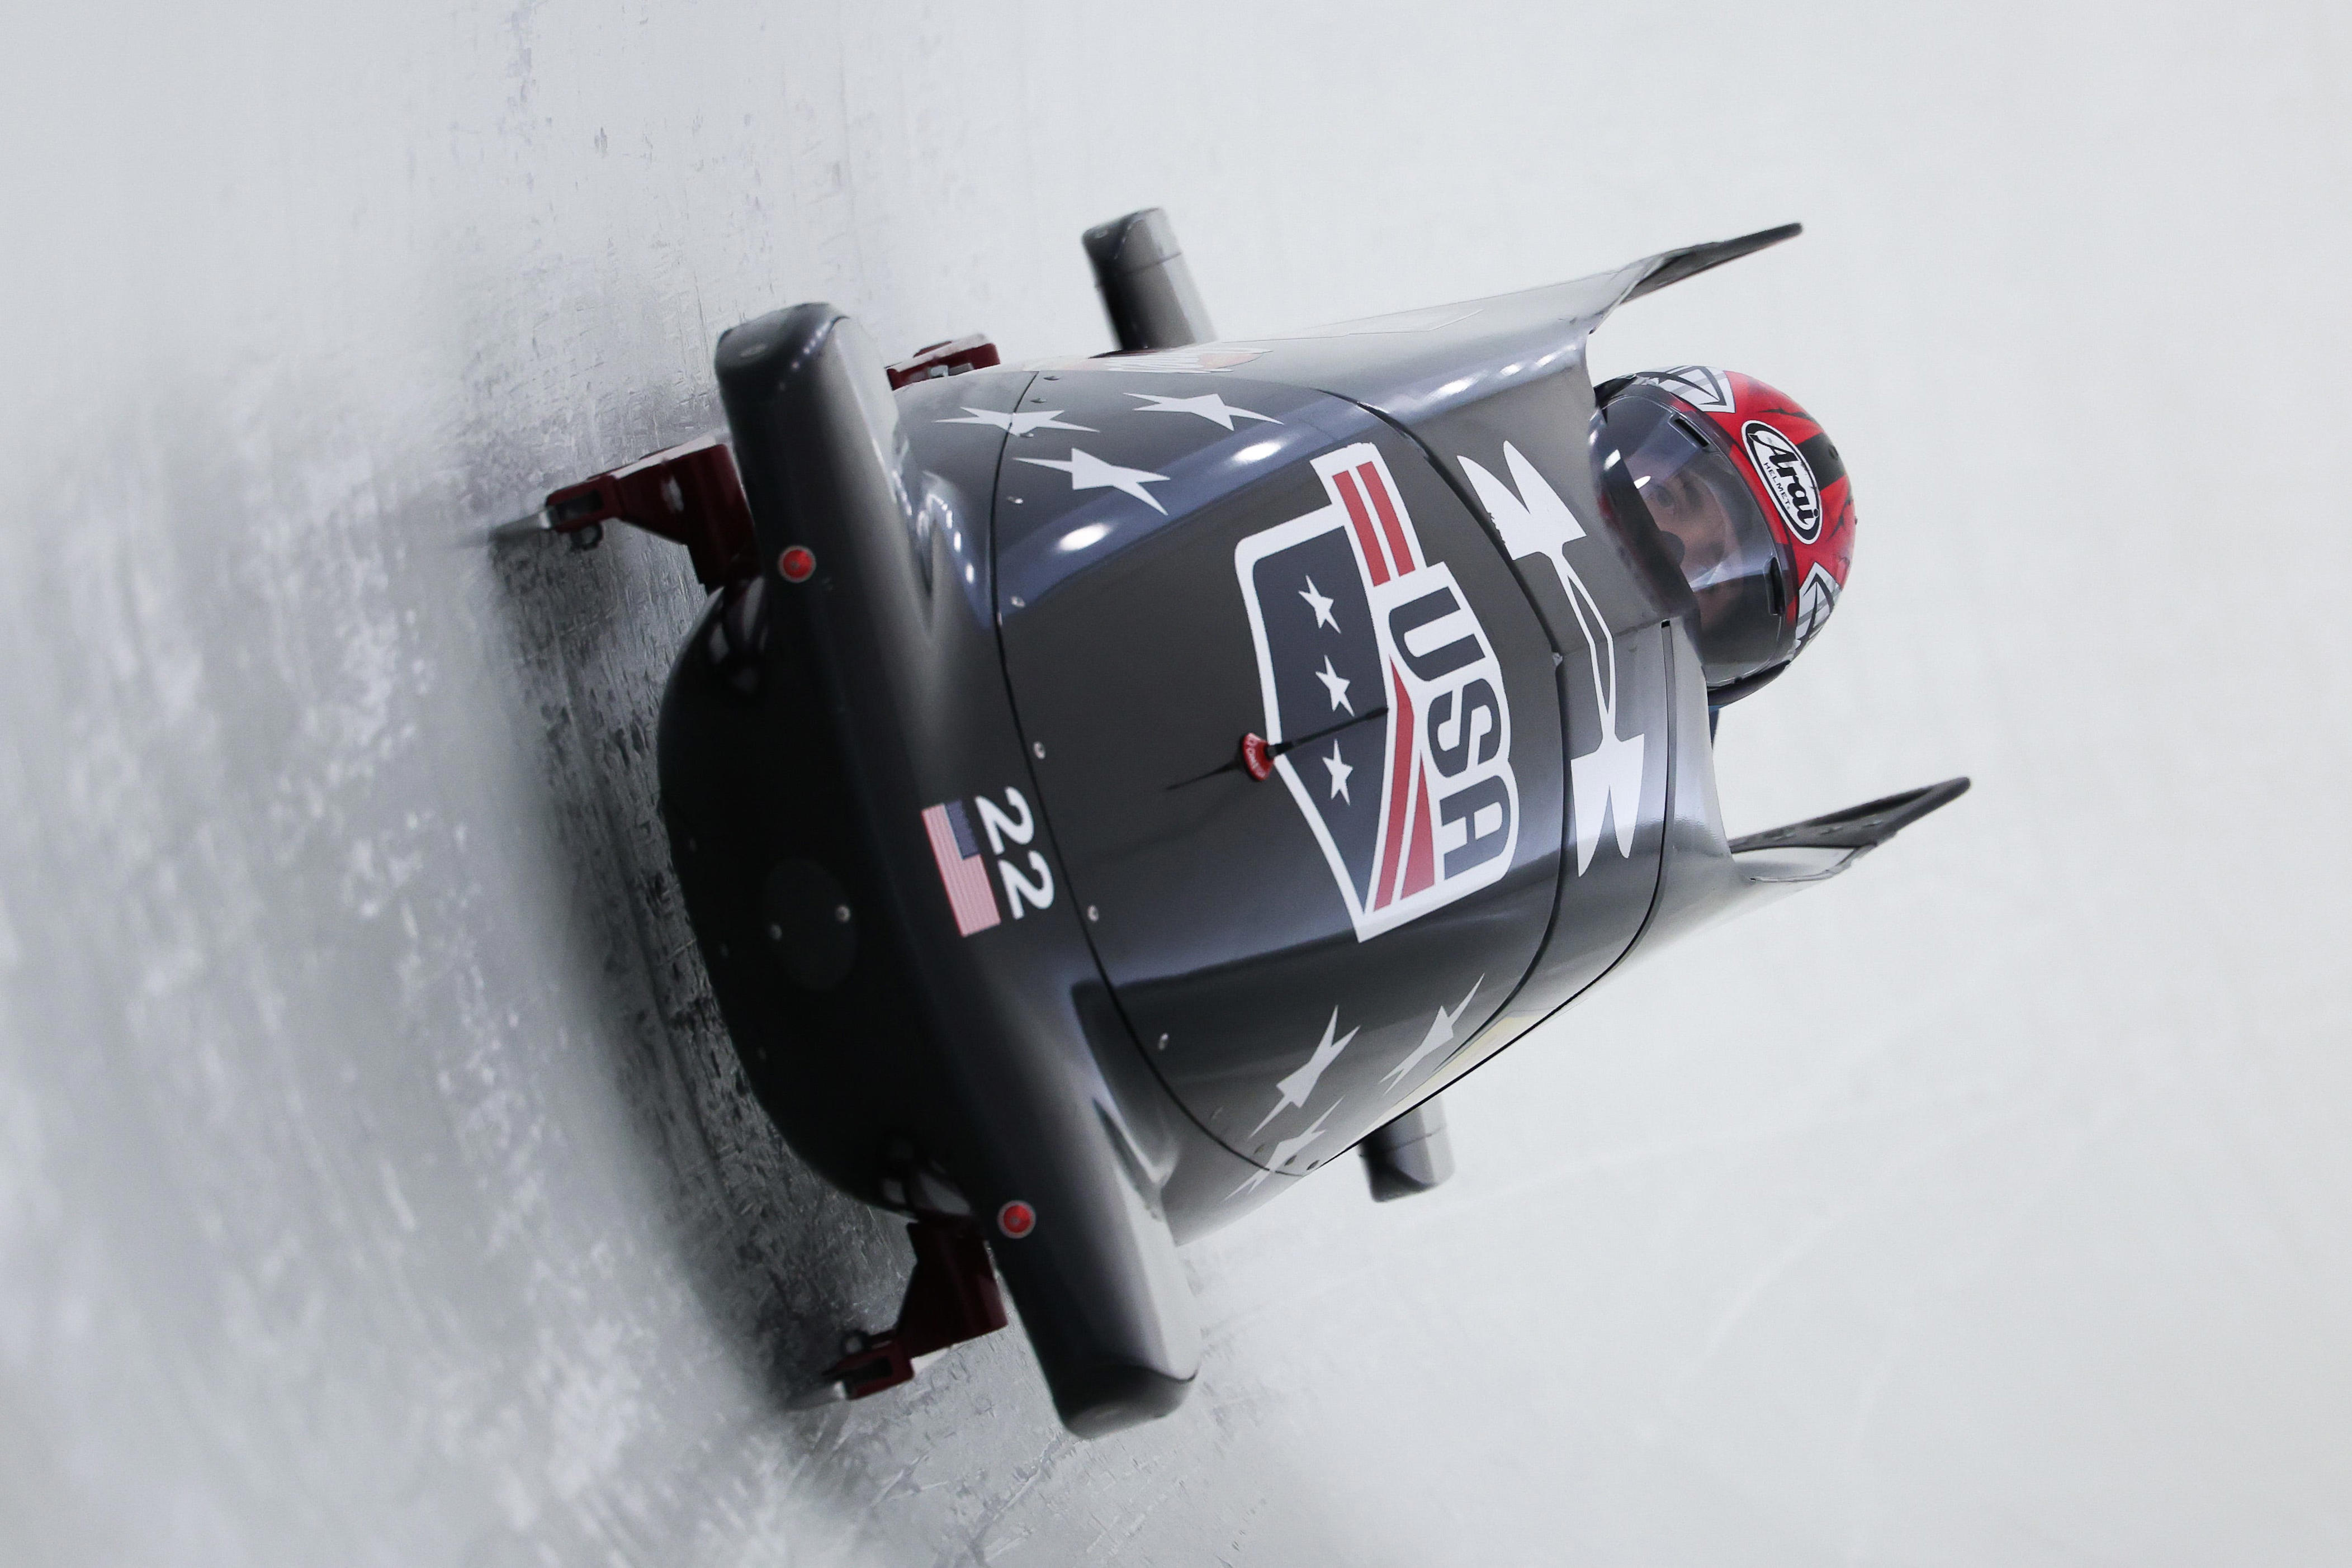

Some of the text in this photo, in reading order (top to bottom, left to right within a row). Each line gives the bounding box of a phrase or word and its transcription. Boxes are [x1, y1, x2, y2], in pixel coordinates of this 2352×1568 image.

[1748, 434, 1819, 525] Arai
[1763, 462, 1790, 506] HELMET
[1388, 586, 1511, 880] USA
[974, 786, 1055, 920] 22
